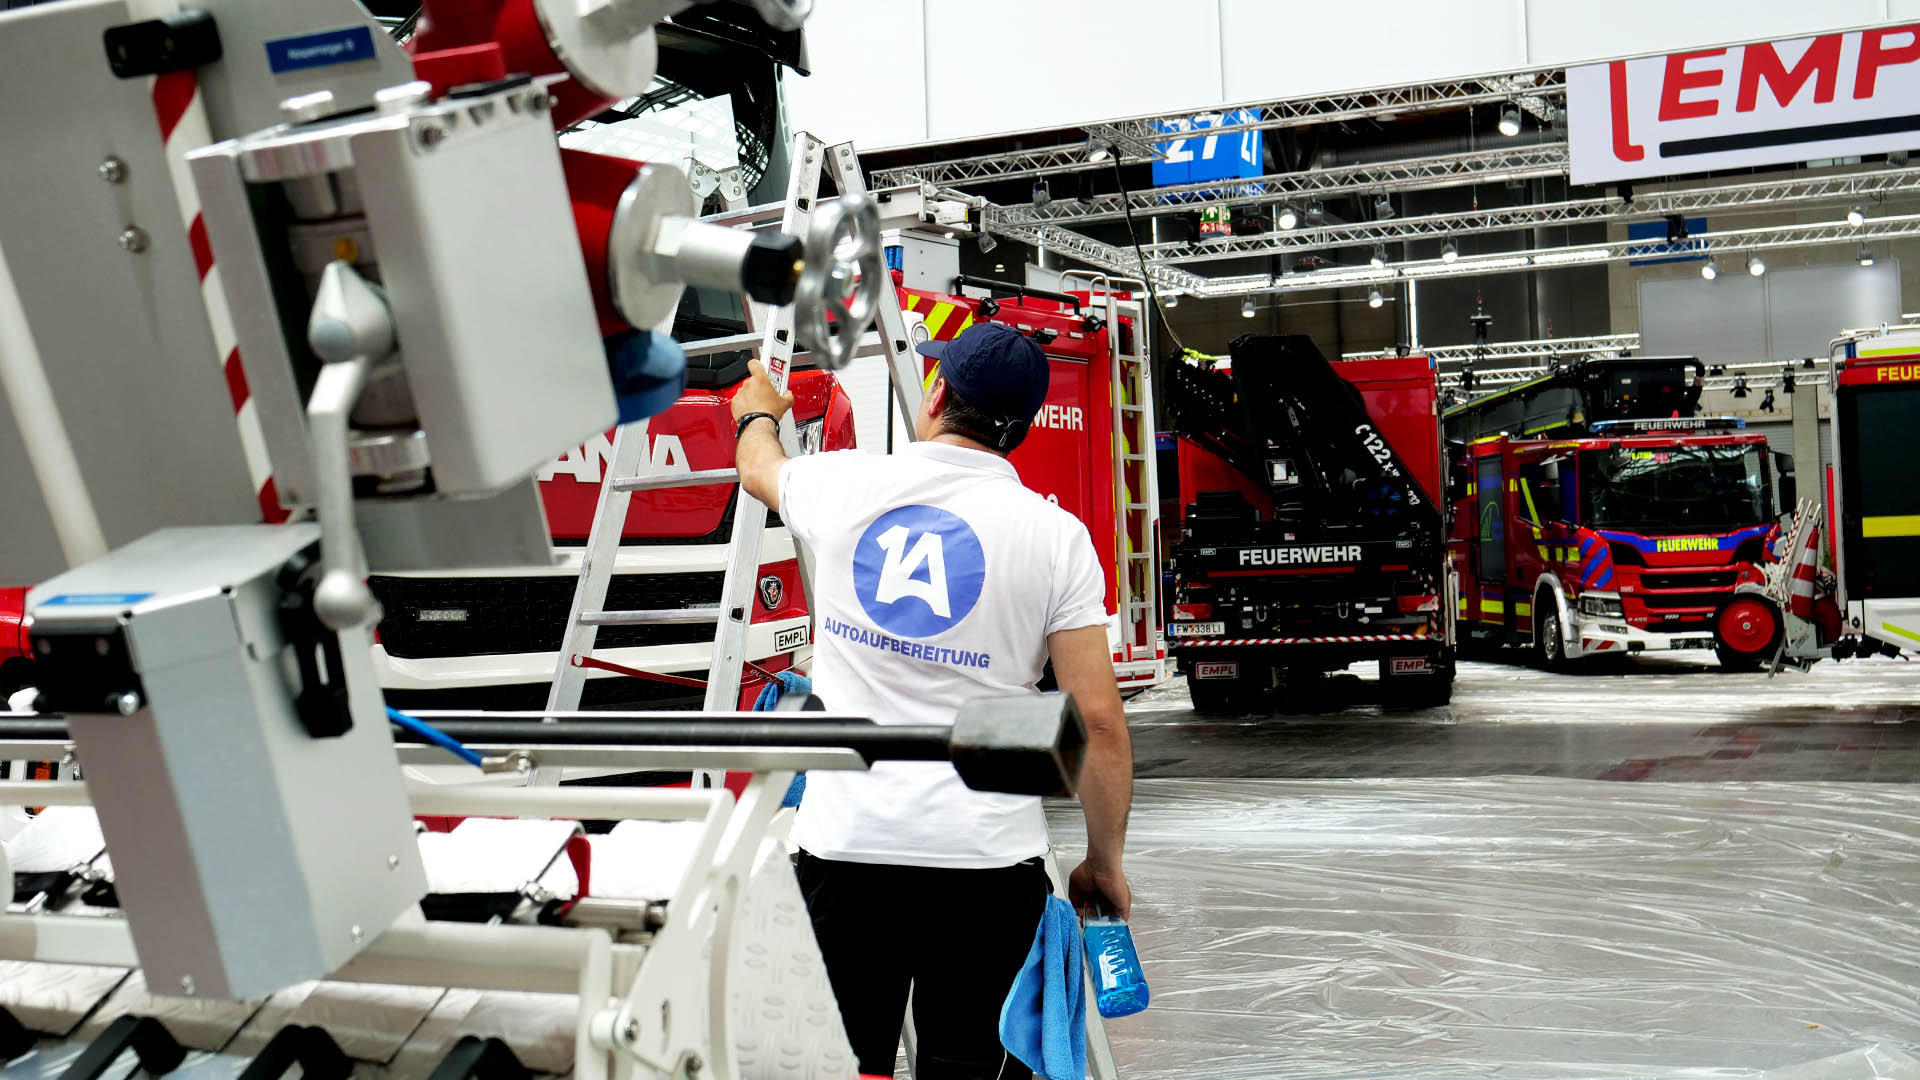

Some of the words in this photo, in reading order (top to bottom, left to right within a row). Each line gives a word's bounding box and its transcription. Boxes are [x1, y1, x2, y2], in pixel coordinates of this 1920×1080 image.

[1163, 113, 1223, 164] 27
[1877, 365, 1920, 382] FEUE
[1031, 404, 1083, 431] WEHR
[1633, 419, 1706, 431] FEUERWEHR
[1656, 537, 1719, 553] FEUERWEHR
[1239, 545, 1362, 566] FEUERWEHR
[875, 525, 952, 619] 1A
[1176, 624, 1188, 633] FW
[778, 631, 805, 647] EMPL
[825, 616, 991, 668] AUTOAUFBEREITUNG
[1201, 665, 1234, 675] EMPL
